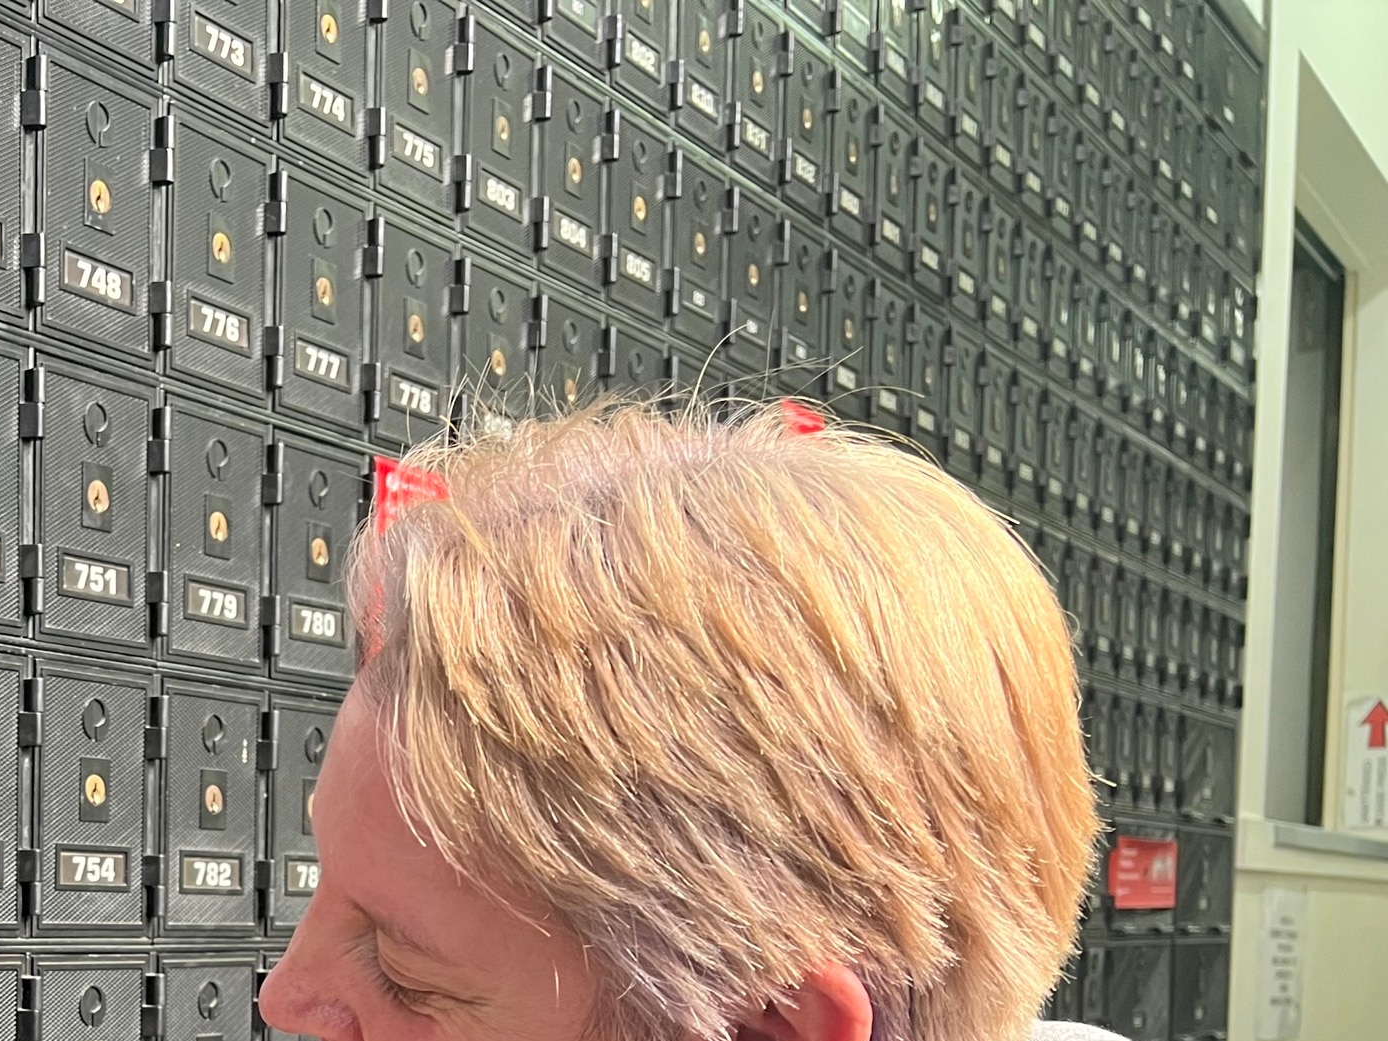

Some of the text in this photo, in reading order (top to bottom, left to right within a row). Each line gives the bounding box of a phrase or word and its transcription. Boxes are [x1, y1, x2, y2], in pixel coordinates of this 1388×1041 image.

[205, 24, 245, 67] 773
[631, 40, 655, 73] 802
[310, 81, 349, 121] 774
[402, 131, 435, 168] 775
[487, 178, 518, 211] 803
[560, 217, 586, 248] 804
[77, 259, 122, 300] 748
[626, 253, 650, 281] 805
[201, 305, 239, 342] 776
[306, 346, 340, 379] 777
[399, 381, 431, 413] 778
[75, 563, 116, 595] 751
[199, 589, 237, 619] 779
[301, 610, 335, 636] 780
[73, 856, 115, 882] 754
[194, 862, 231, 886] 782
[297, 865, 319, 888] 78
